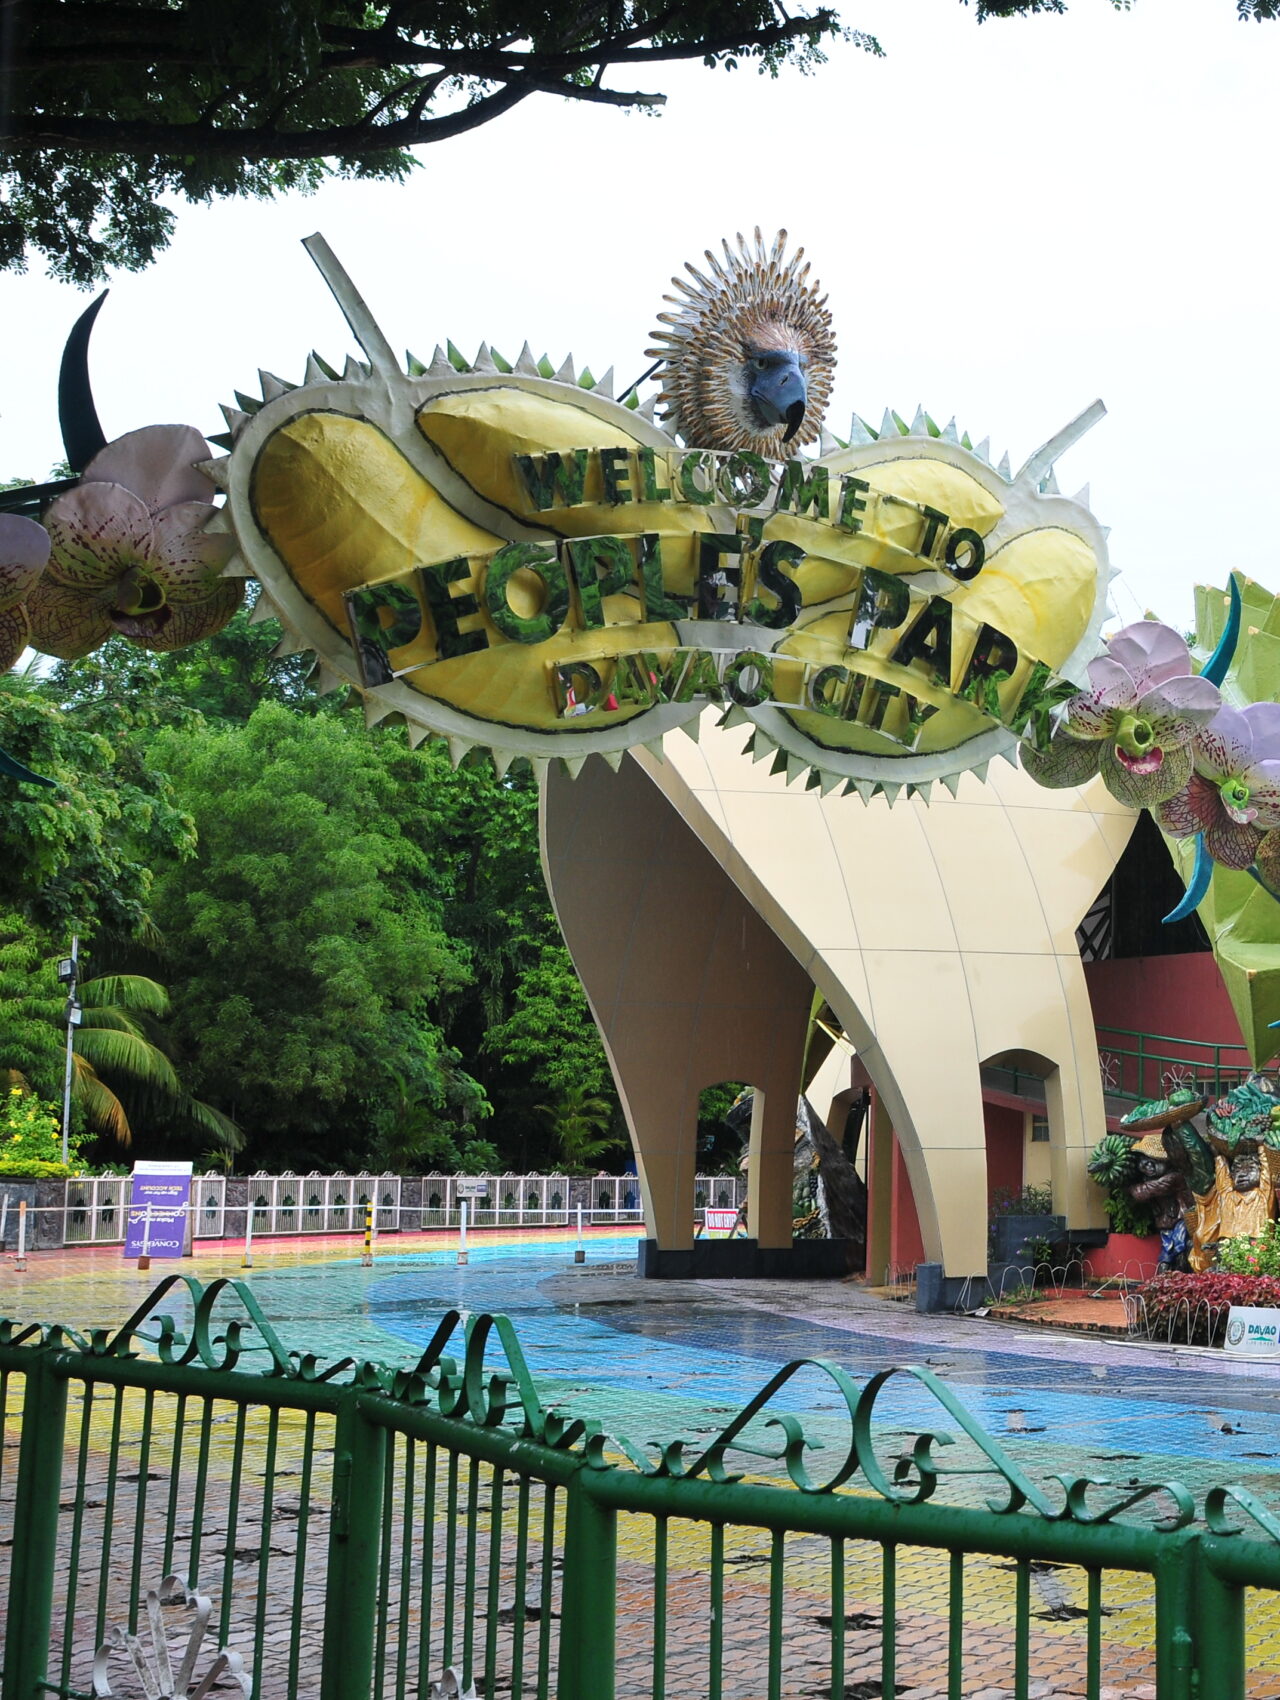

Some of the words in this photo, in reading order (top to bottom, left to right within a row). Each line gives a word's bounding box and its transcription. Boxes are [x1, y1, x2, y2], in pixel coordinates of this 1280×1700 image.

[515, 446, 870, 533] WELCOME
[918, 504, 985, 582] TO
[556, 650, 774, 719] DAVAO
[807, 664, 940, 752] CITY
[849, 567, 1084, 752] PARK
[131, 1240, 179, 1248] CONVEGYS
[1248, 1324, 1277, 1336] DAVAO
